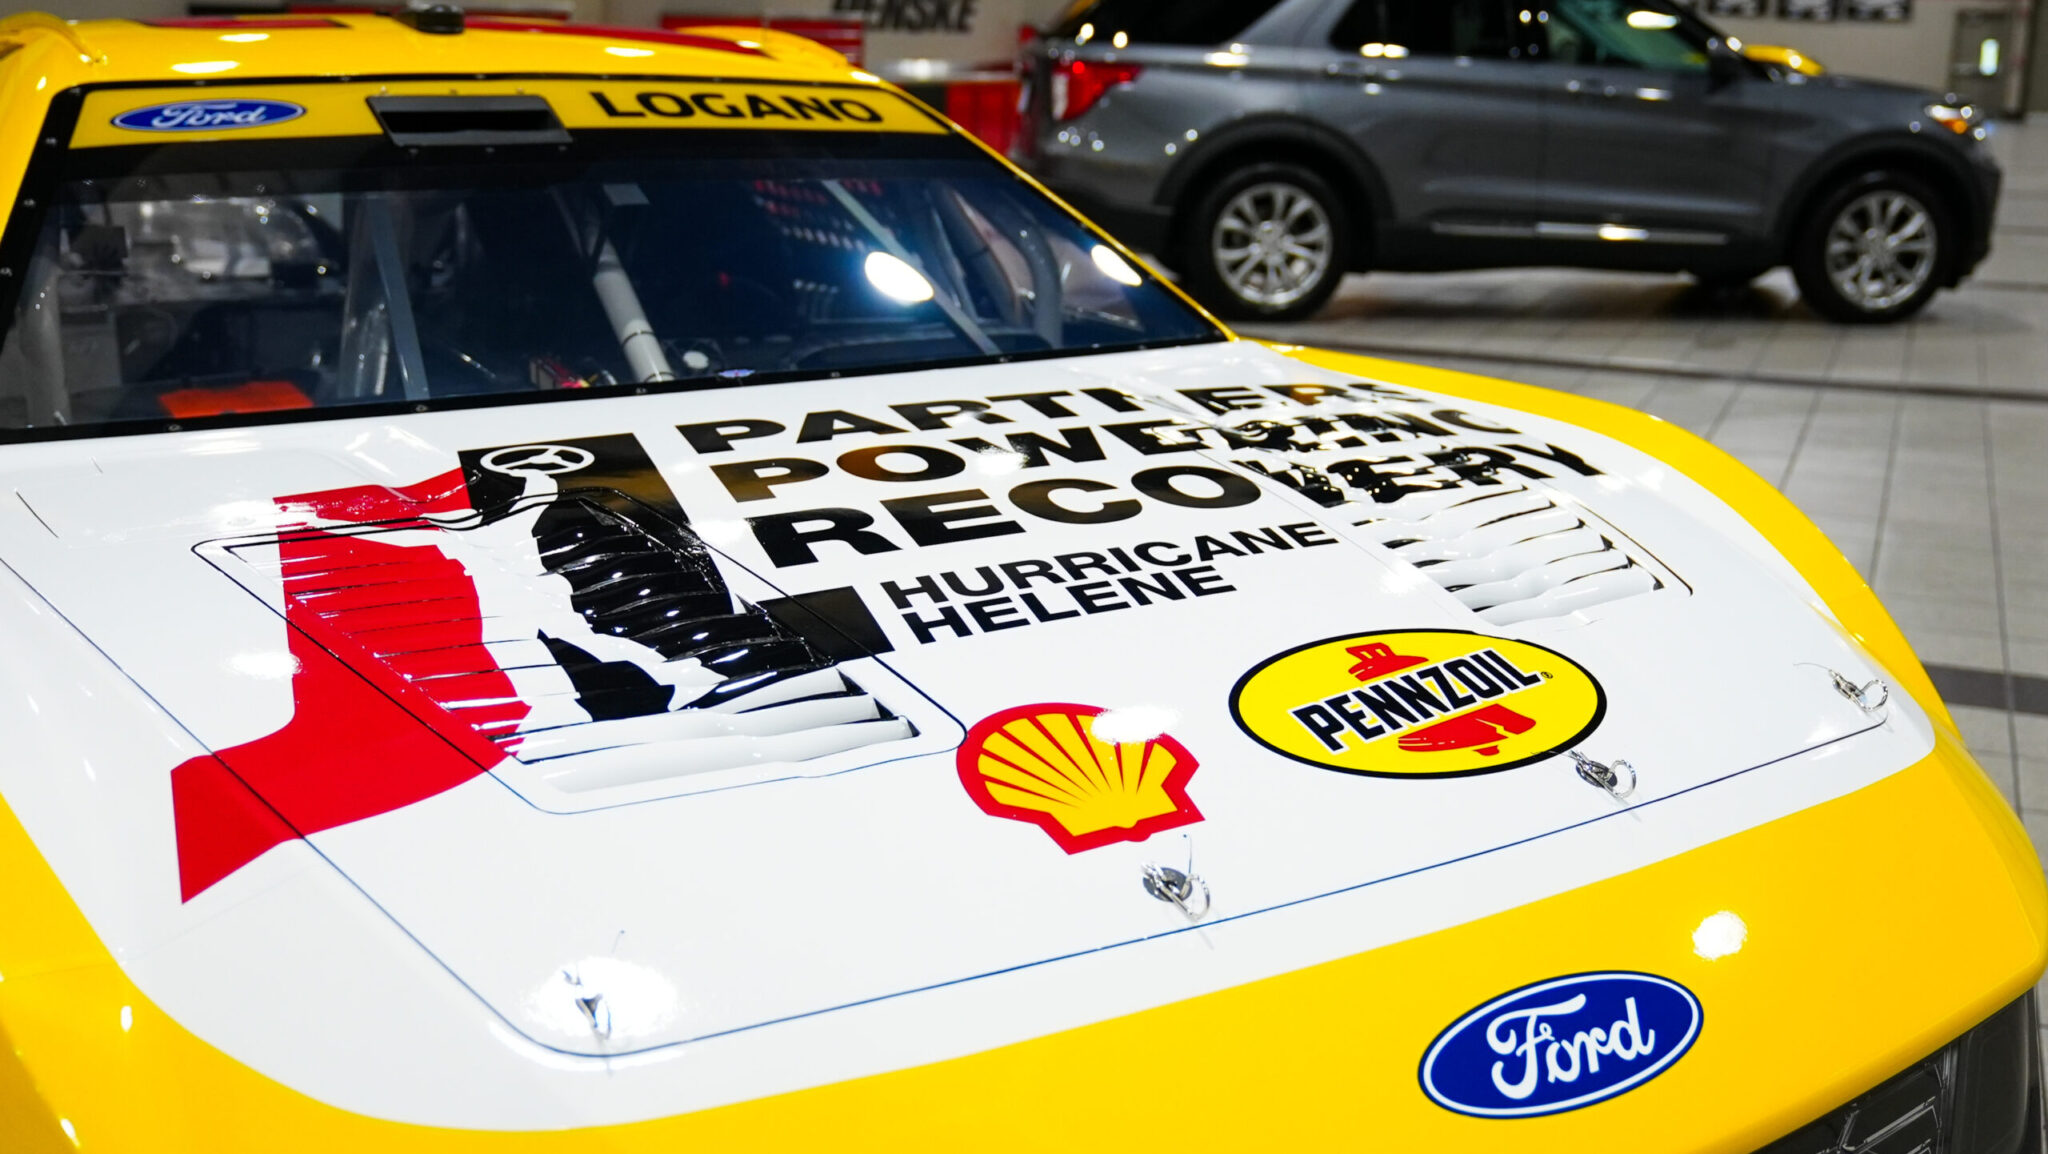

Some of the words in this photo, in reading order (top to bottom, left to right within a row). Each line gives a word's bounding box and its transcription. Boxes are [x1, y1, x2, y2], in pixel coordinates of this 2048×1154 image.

[152, 102, 267, 129] Ford
[589, 91, 884, 123] LOGANO
[745, 444, 1607, 569] RECOVERY
[880, 521, 1340, 610] HURRICANE
[901, 564, 1238, 645] HELENE
[1291, 648, 1542, 752] PENNZOIL
[1486, 993, 1656, 1100] Ford
